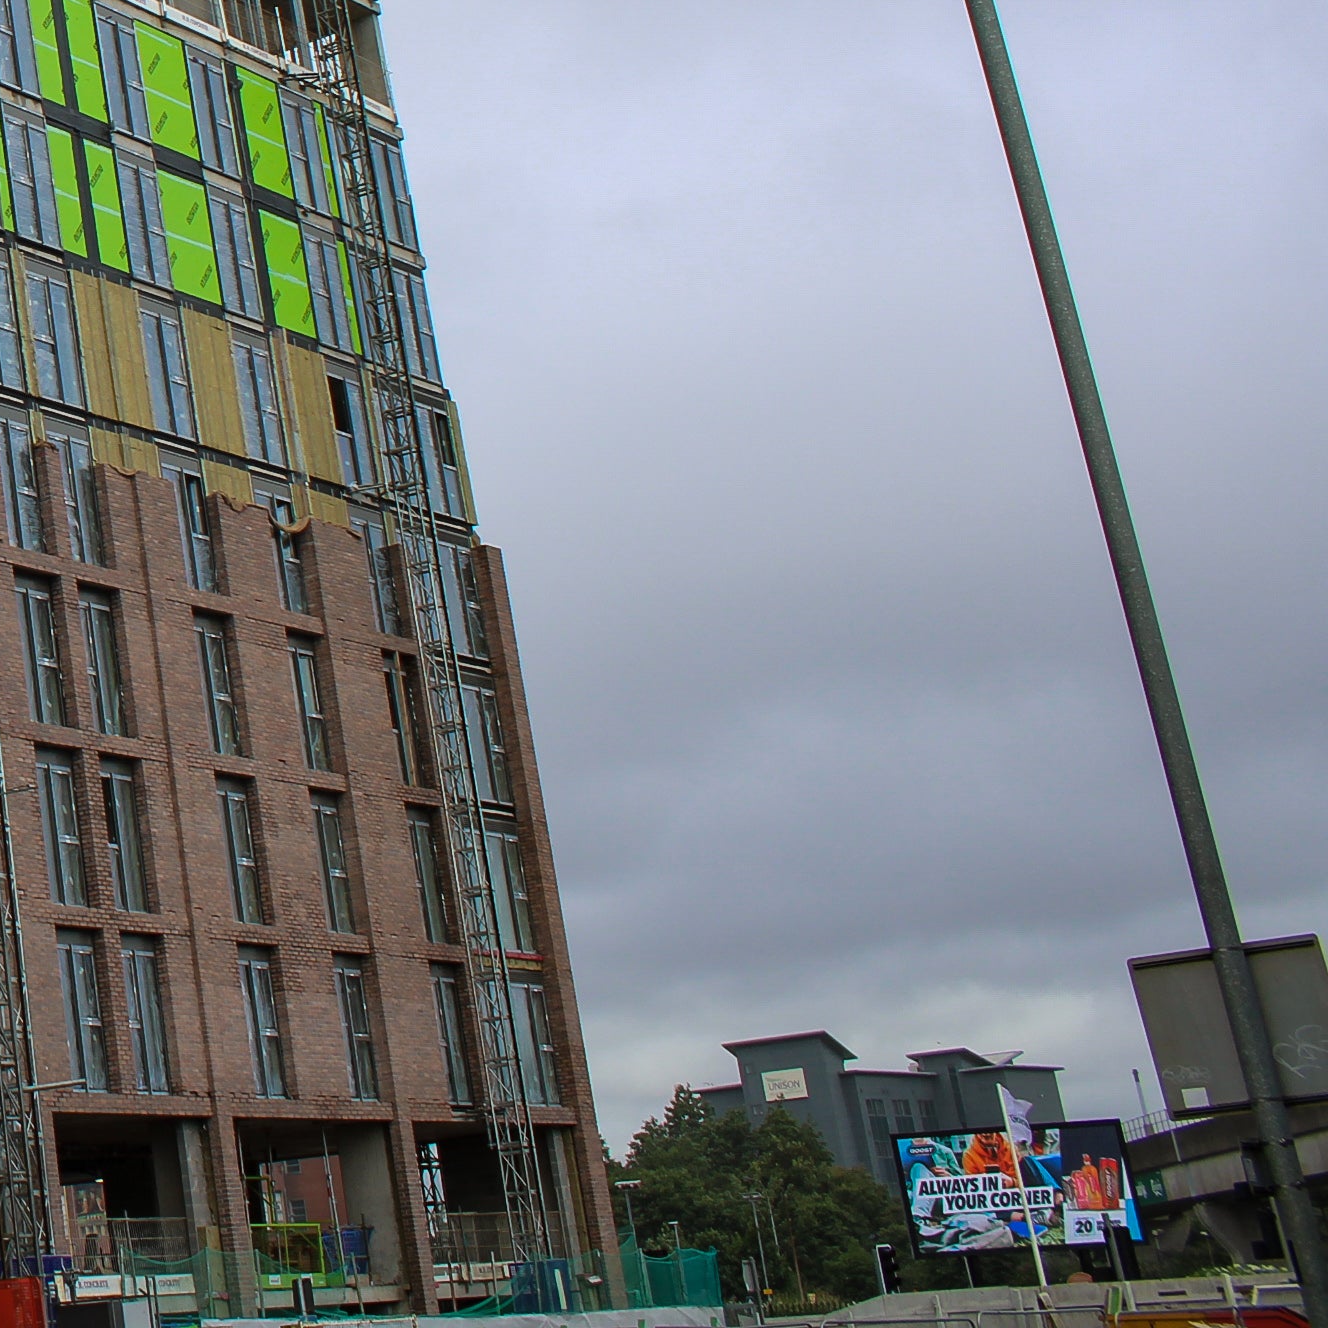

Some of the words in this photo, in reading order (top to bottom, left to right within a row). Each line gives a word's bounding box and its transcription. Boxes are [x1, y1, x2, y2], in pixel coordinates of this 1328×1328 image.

[918, 1176, 979, 1196] ALWAYS
[982, 1175, 999, 1191] IN
[944, 1192, 988, 1211] YOUR
[1075, 1220, 1093, 1234] 20
